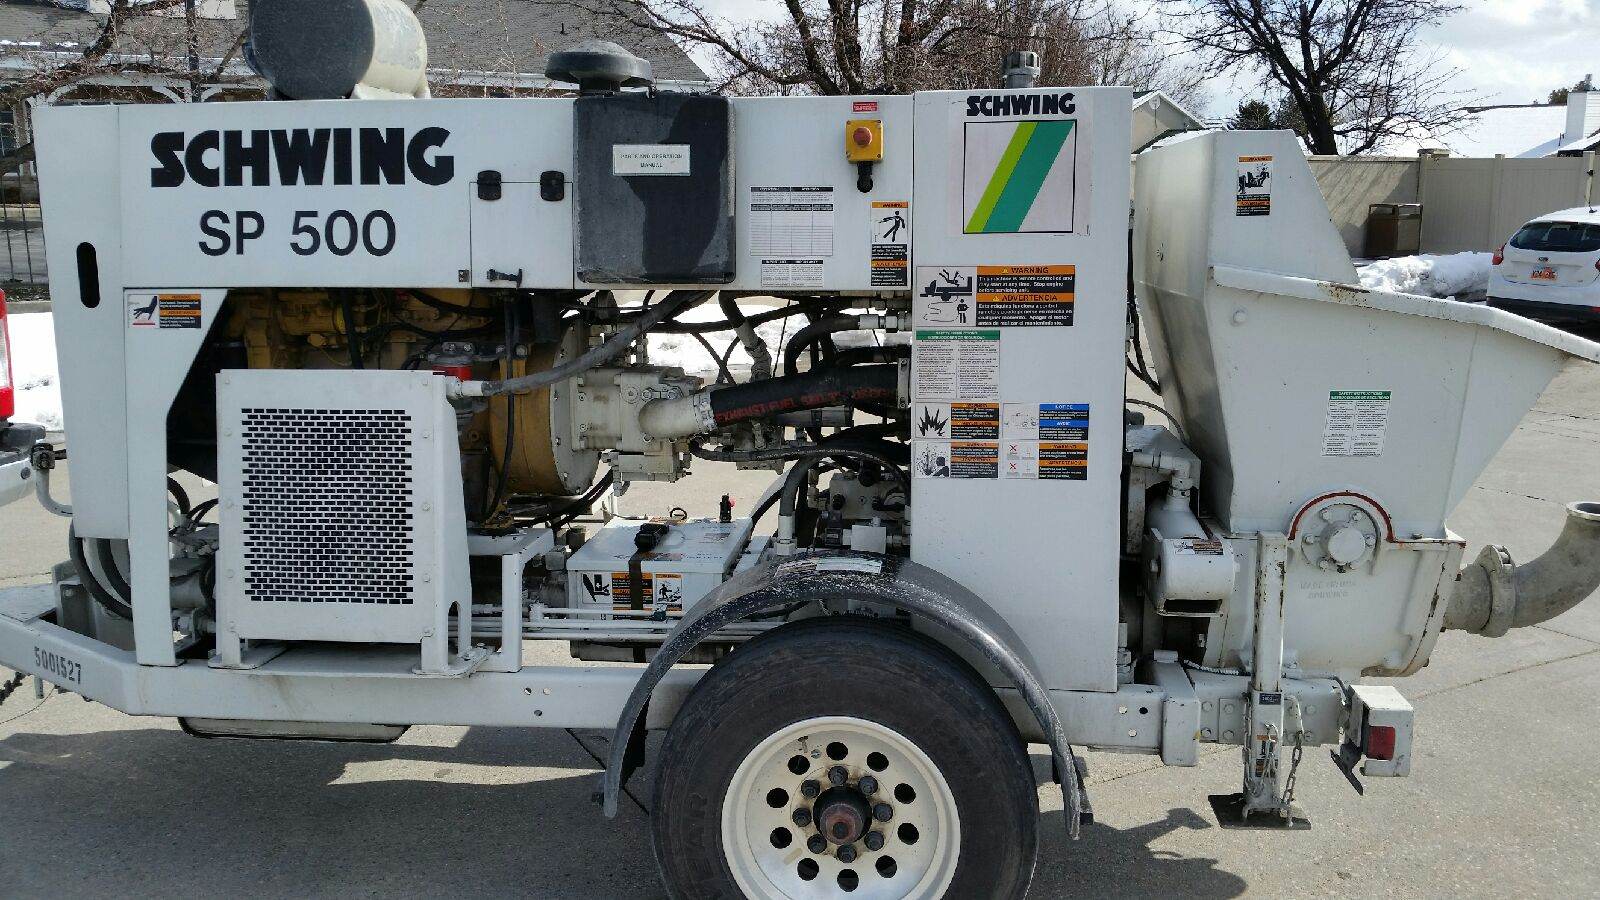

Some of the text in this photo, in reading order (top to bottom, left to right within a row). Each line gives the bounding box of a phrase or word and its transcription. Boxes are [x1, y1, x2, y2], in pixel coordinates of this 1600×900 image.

[967, 92, 1076, 117] SCHWING
[150, 126, 454, 188] SCHWING
[198, 209, 397, 257] SP 500
[1001, 294, 1058, 302] ADVERTENCIA
[34, 645, 82, 685] 5001527
